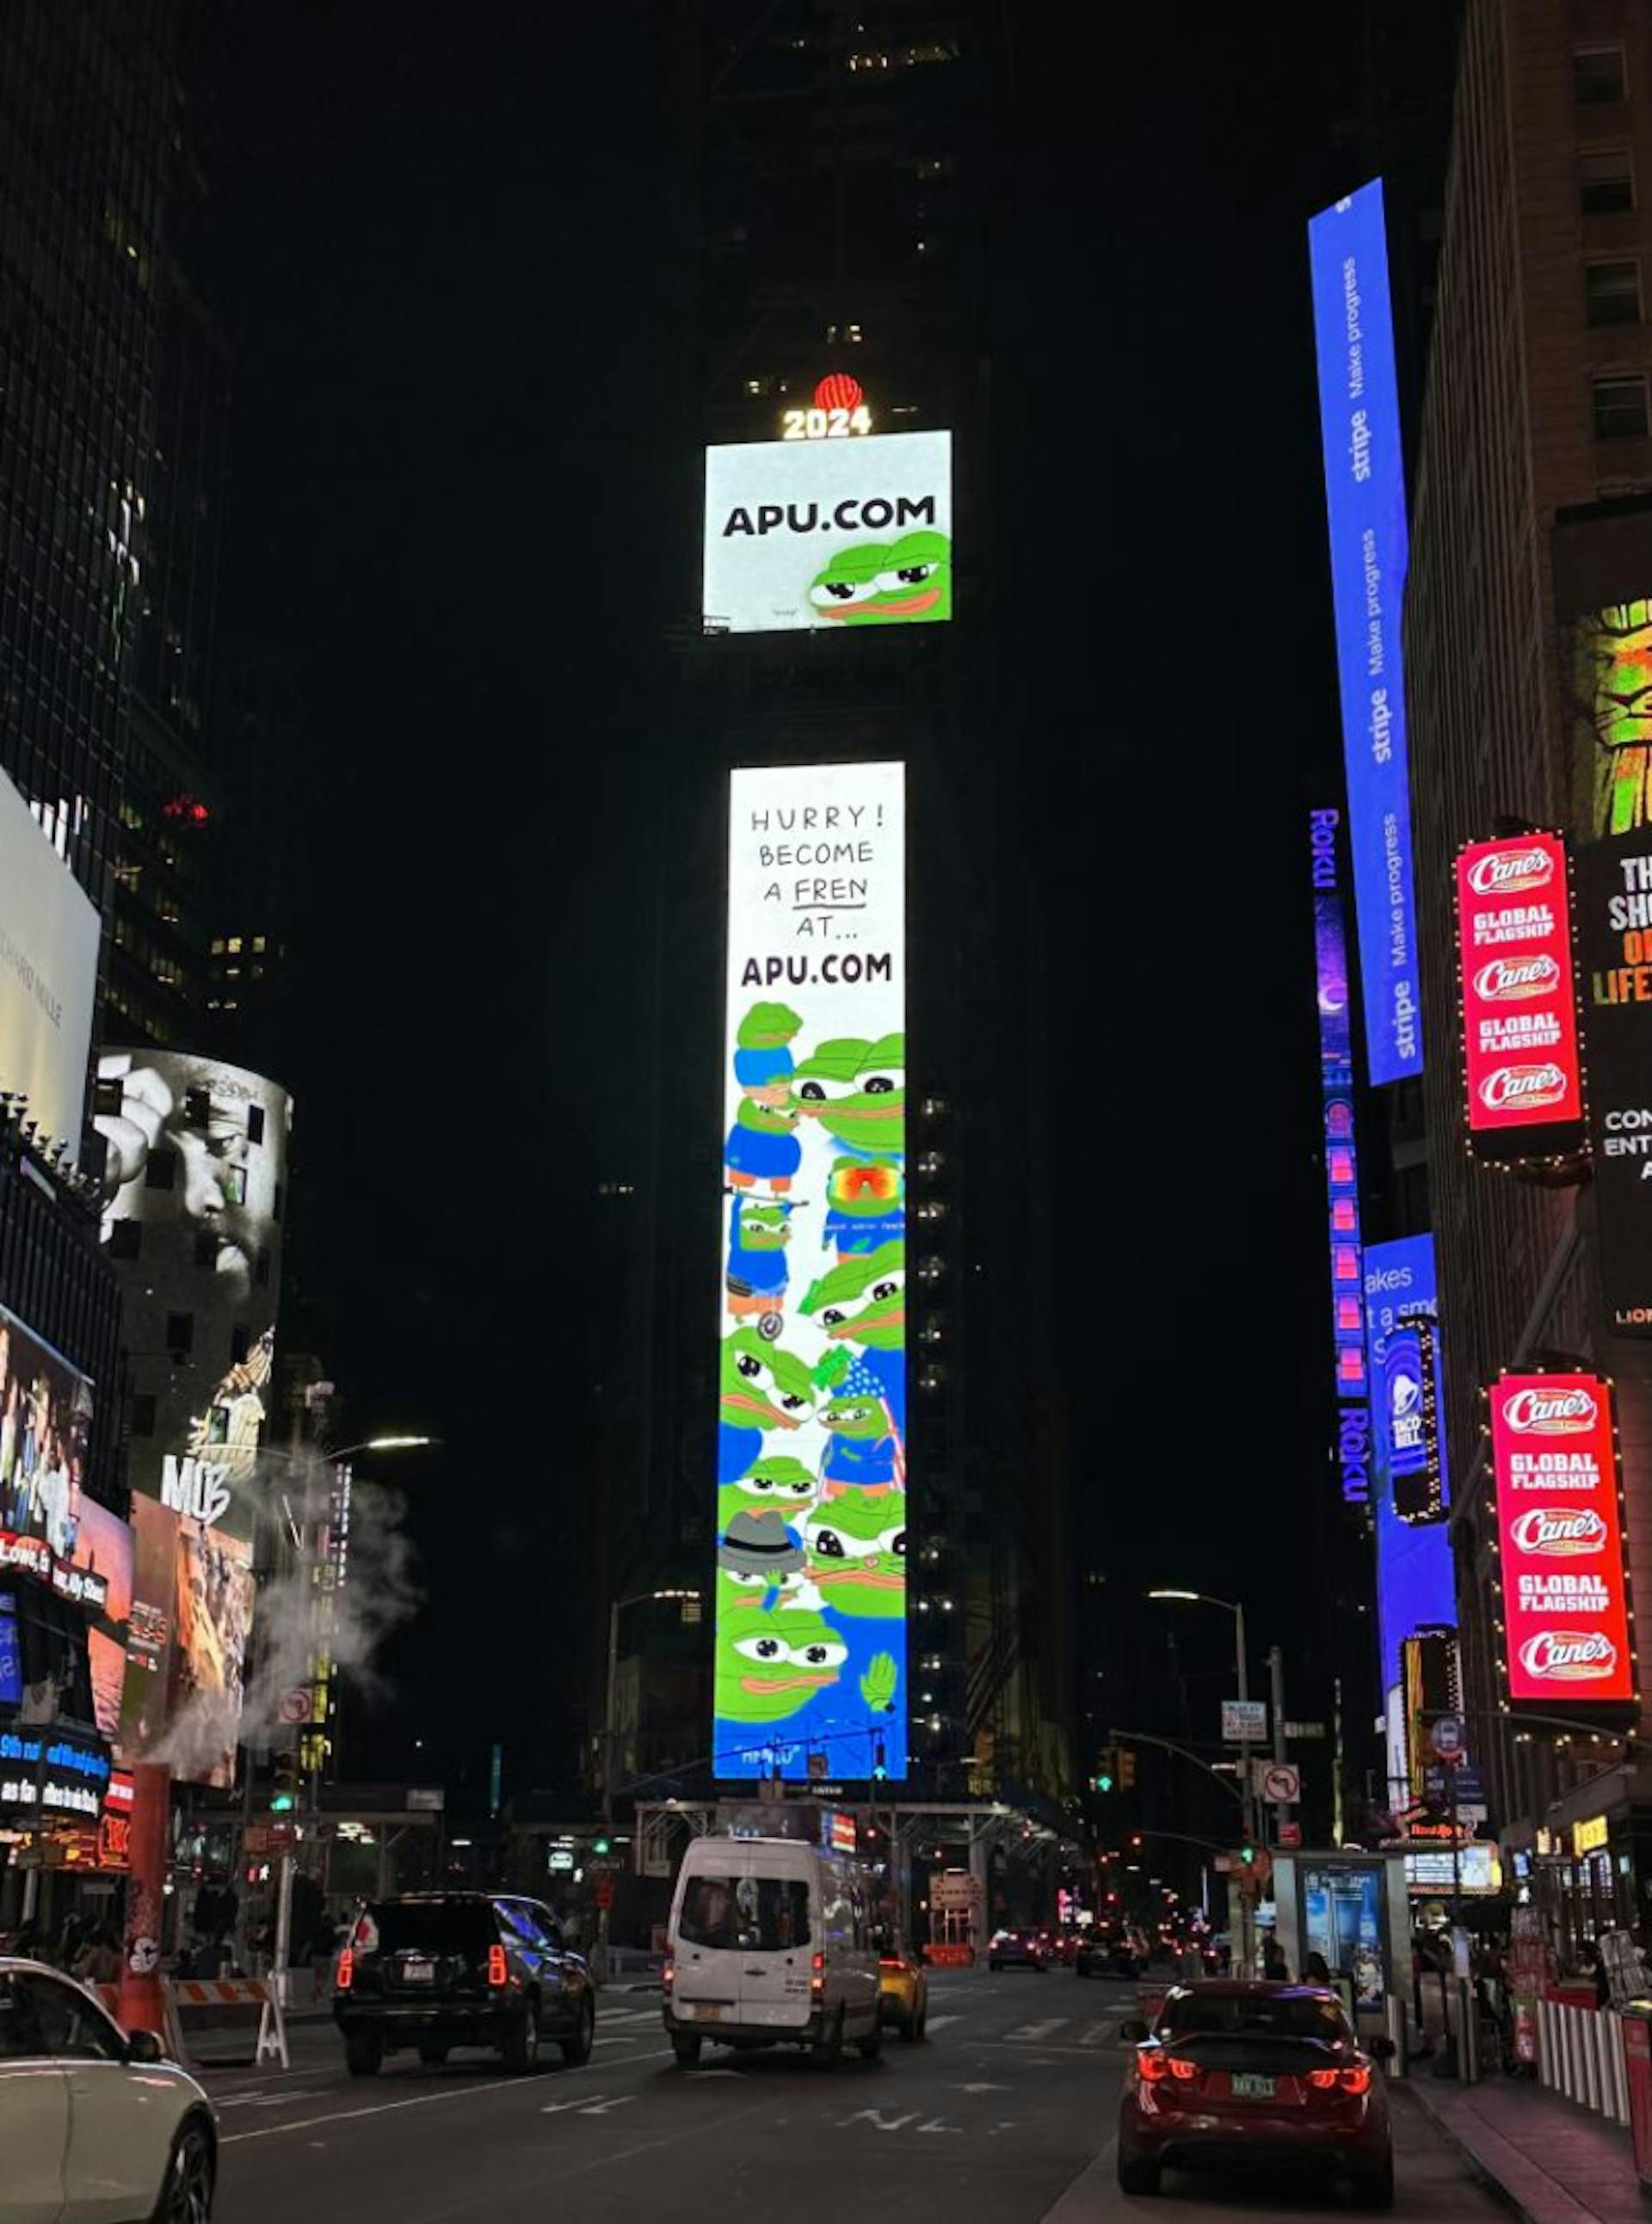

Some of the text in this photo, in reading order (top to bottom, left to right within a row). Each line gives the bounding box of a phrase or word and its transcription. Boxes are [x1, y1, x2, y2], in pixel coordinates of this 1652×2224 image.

[1343, 256, 1372, 483] stripe Make progress
[784, 406, 872, 440] 2024
[723, 496, 935, 537] APU.COM
[1361, 528, 1393, 764] stripe Make progress
[760, 841, 873, 867] BECOME
[764, 878, 868, 903] A FREN
[1473, 904, 1553, 931] GLOBAL
[1383, 812, 1417, 1060] stripe Make progress
[1474, 922, 1554, 946] FLAGSHIP
[741, 952, 891, 987] APU.COM
[1480, 1012, 1560, 1038] GLOBAL
[1480, 1030, 1561, 1053] FLAGSHIP
[1510, 1452, 1598, 1475] GLOBAL
[1511, 1472, 1600, 1490] FLAGSHIP
[1519, 1574, 1607, 1596] GLOBAL
[1519, 1594, 1609, 1612] FLAGSHIP
